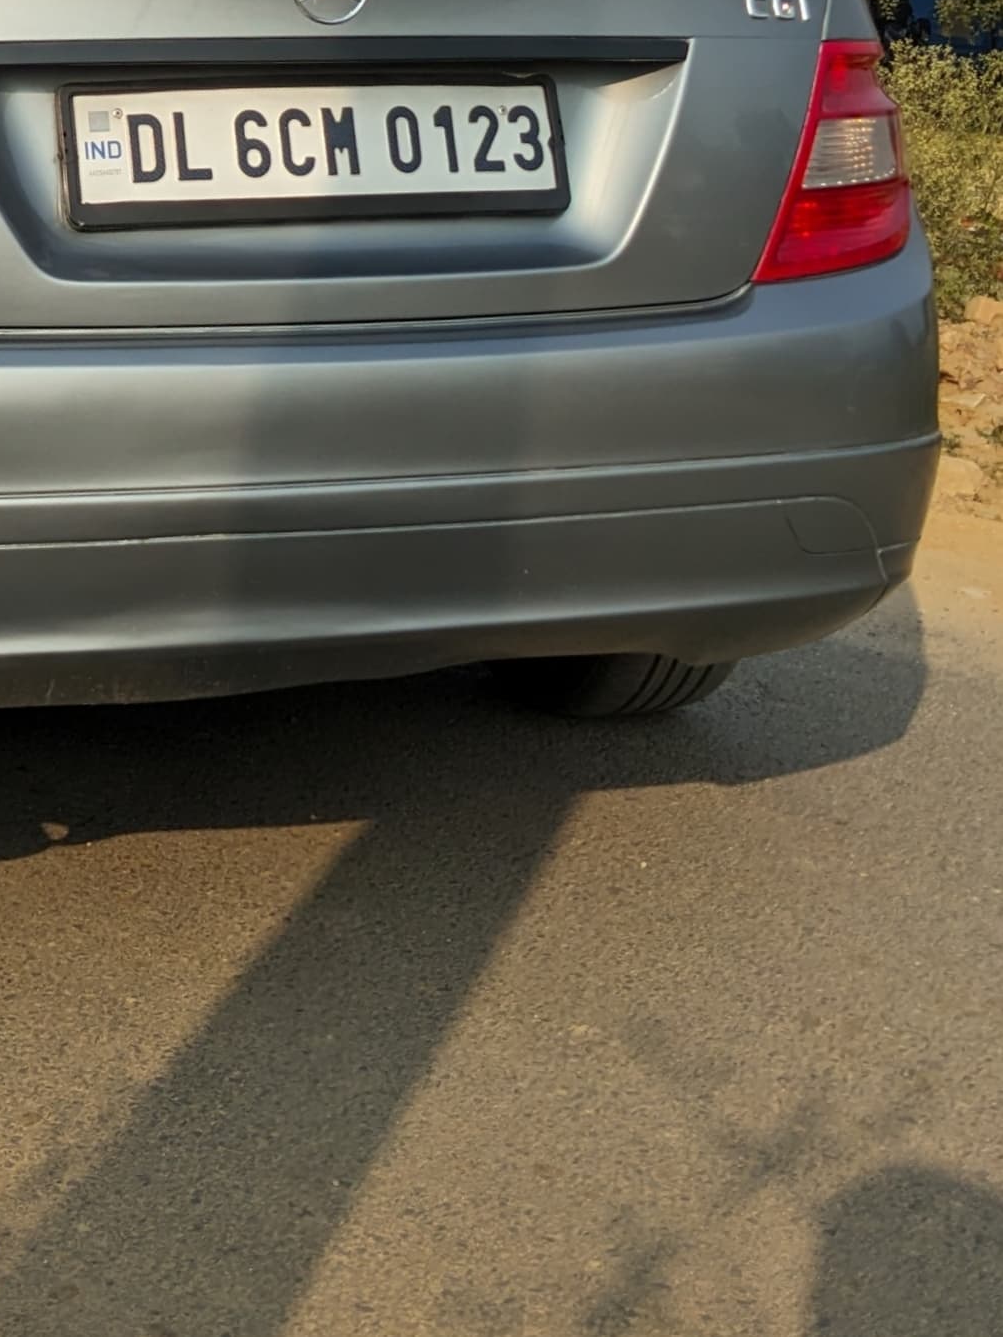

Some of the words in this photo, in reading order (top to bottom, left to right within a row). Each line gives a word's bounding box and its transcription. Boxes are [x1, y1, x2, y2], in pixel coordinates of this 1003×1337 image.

[84, 140, 122, 160] IND
[126, 112, 213, 183] DL
[234, 106, 361, 177] 6CM
[386, 105, 543, 174] 0123
